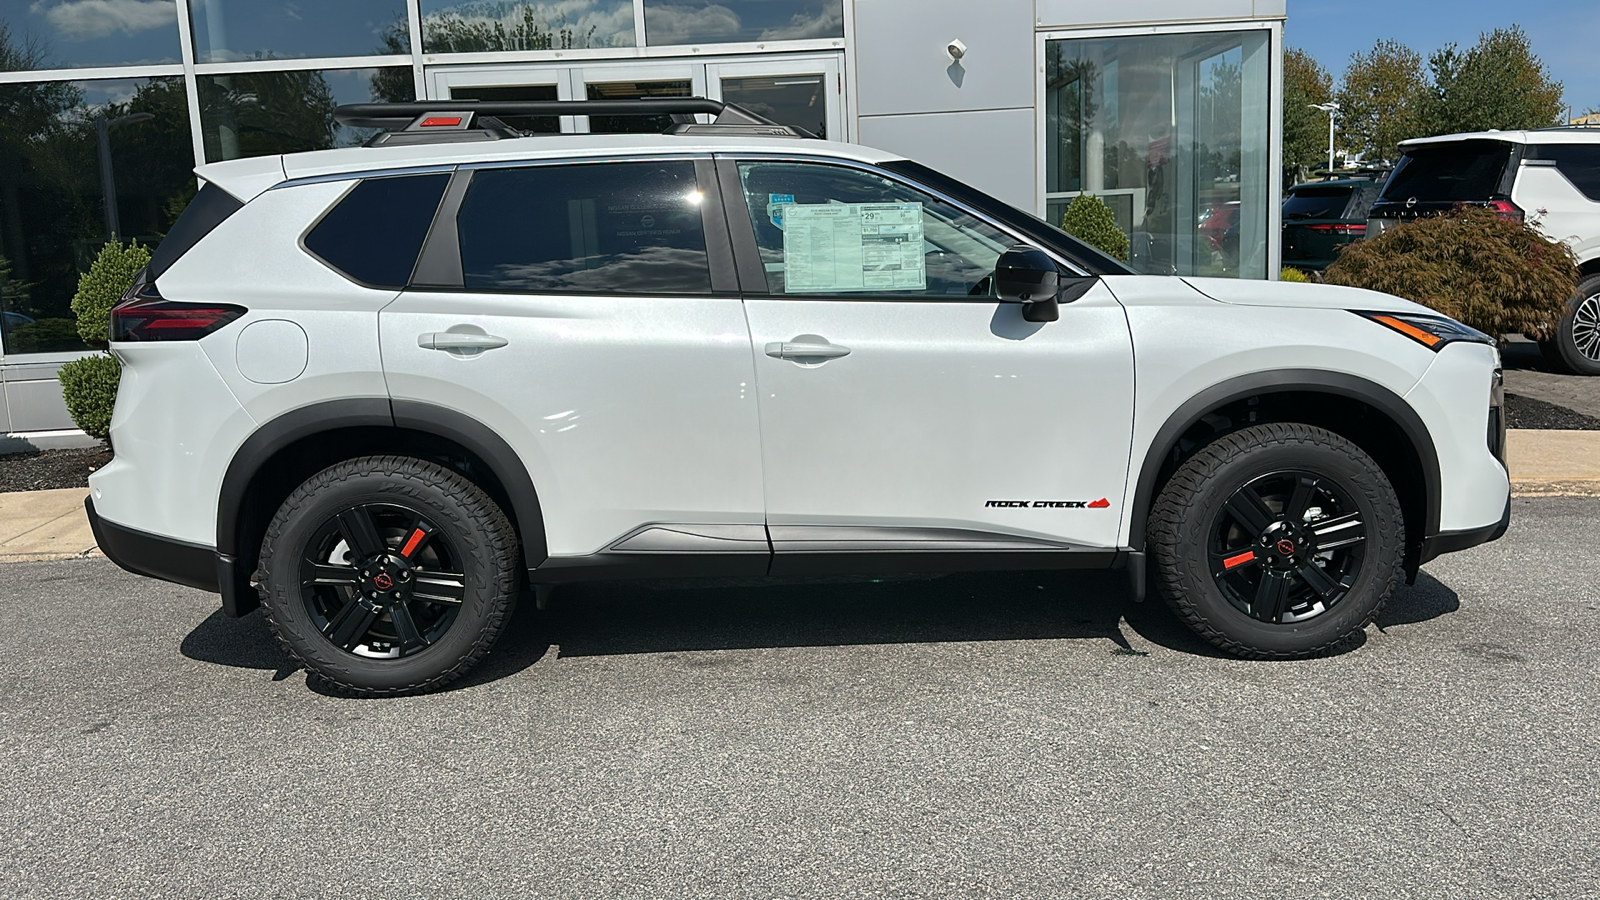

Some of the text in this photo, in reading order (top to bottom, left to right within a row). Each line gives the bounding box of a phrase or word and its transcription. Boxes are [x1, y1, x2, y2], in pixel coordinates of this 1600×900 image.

[864, 212, 875, 220] 29
[985, 500, 1088, 509] ROCK CREEK
